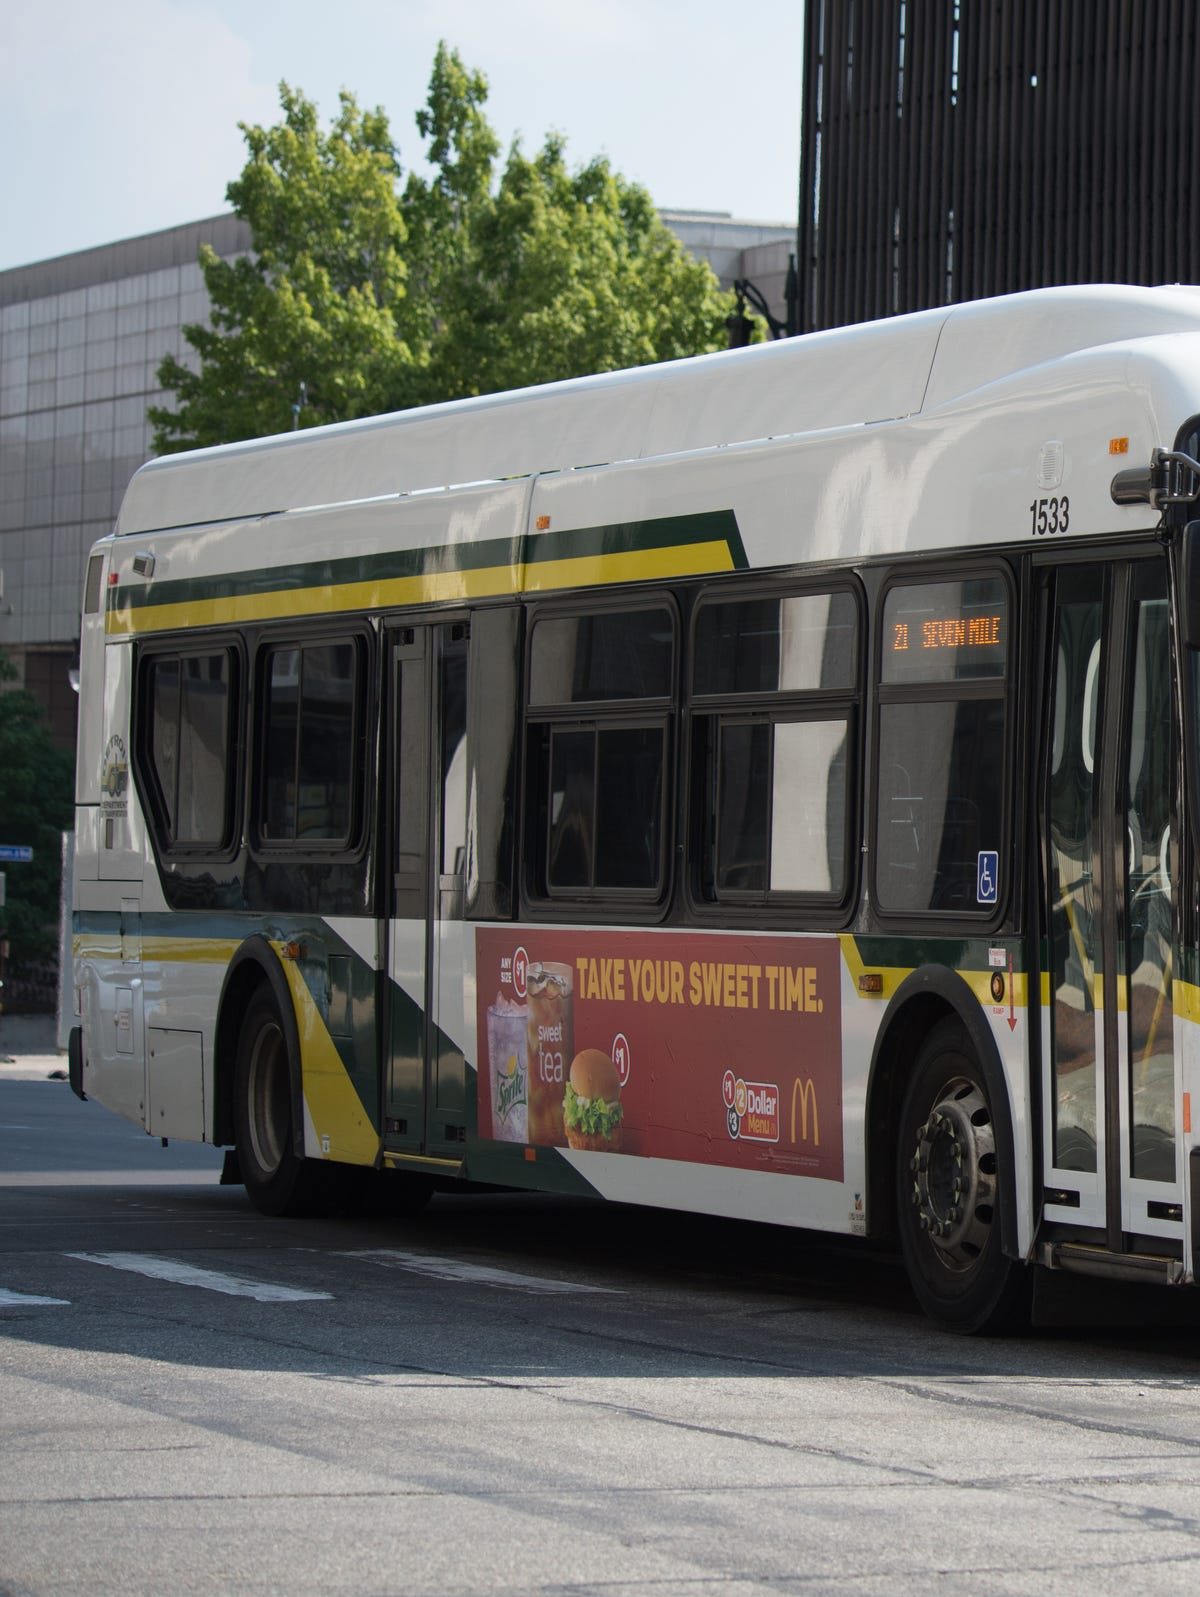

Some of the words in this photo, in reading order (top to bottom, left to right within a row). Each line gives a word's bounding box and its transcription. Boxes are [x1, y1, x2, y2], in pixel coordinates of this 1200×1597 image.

[1030, 496, 1069, 535] 1533
[893, 624, 908, 649] 21
[922, 620, 965, 647] SEVEN
[969, 617, 1001, 644] MILE
[501, 957, 512, 969] ANY
[501, 972, 512, 983] SIZE
[576, 957, 625, 1001] TAKE
[629, 959, 685, 1004] YOUR
[689, 961, 762, 1009] SWEET
[766, 965, 823, 1013] TIME.
[538, 1022, 562, 1042] sweet
[539, 1042, 563, 1083] tea
[498, 1073, 523, 1114] Sprite
[748, 1090, 776, 1115] Dollar
[747, 1114, 770, 1134] Menu
